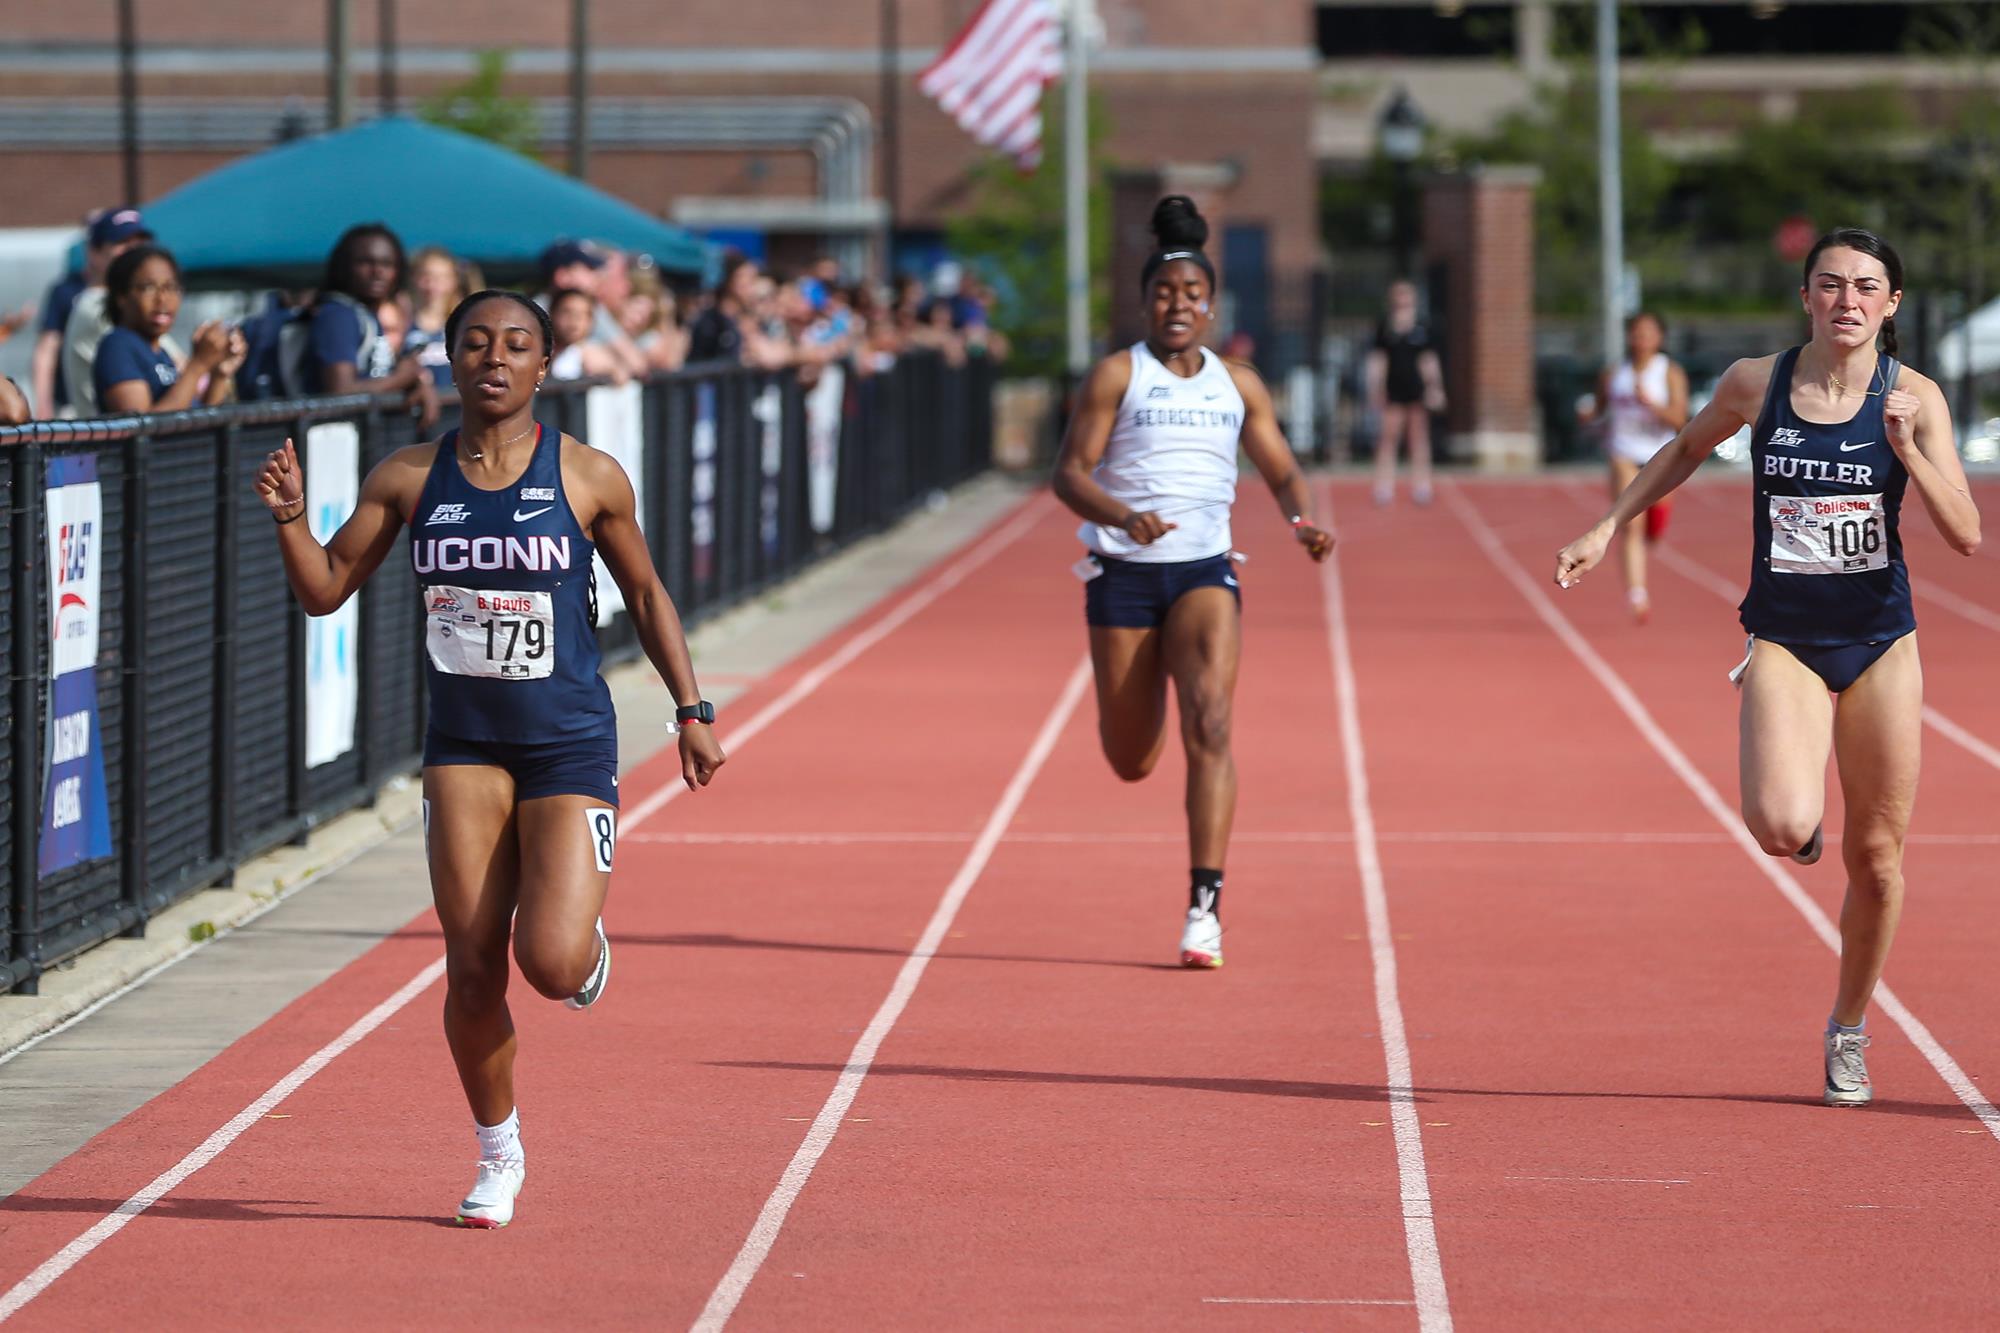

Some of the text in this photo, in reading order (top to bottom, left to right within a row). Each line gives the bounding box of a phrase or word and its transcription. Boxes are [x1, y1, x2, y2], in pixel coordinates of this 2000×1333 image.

[1134, 408, 1238, 427] GEORGETOWN
[1774, 427, 1801, 437] BIG
[1770, 434, 1806, 446] EAST
[1763, 454, 1873, 486] BUTLER
[434, 503, 465, 513] BIG
[428, 512, 472, 523] EAST
[1774, 514, 1803, 522] EAST
[1822, 517, 1880, 558] 106
[413, 536, 571, 574] UCONN
[434, 597, 457, 605] BIG
[477, 597, 531, 612] B. Davis
[480, 619, 545, 661] 179
[595, 813, 612, 867] 8
